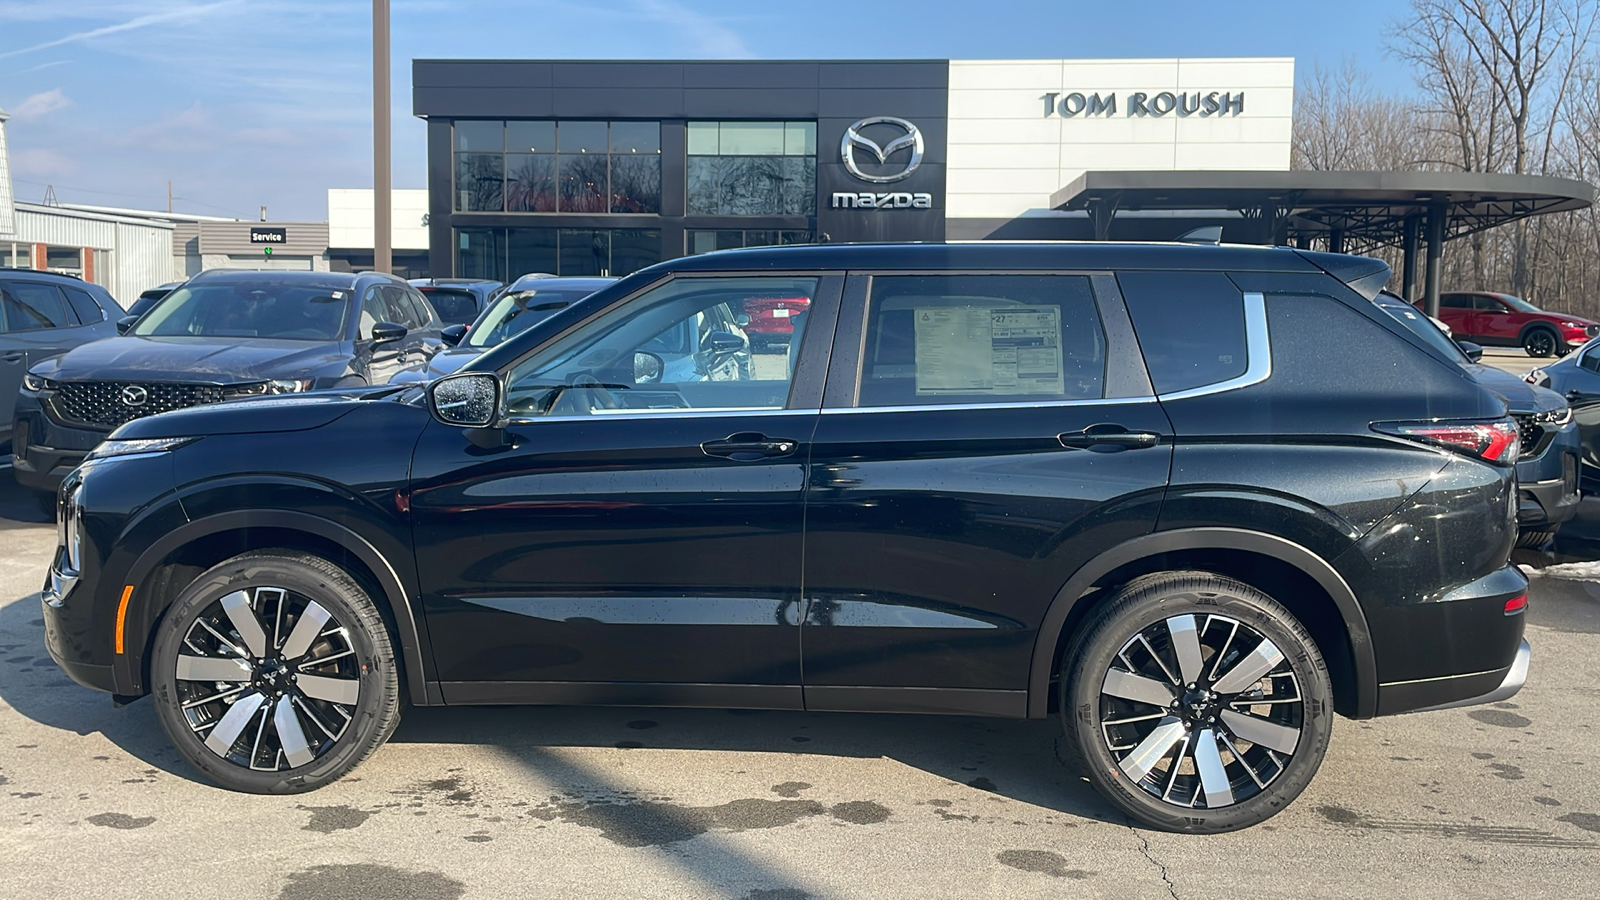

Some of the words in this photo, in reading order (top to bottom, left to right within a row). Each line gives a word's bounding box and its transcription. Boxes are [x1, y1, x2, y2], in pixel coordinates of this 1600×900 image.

[1040, 92, 1117, 118] TOM
[1128, 92, 1244, 118] ROUSH
[252, 232, 281, 242] Service
[995, 315, 1006, 323] 27
